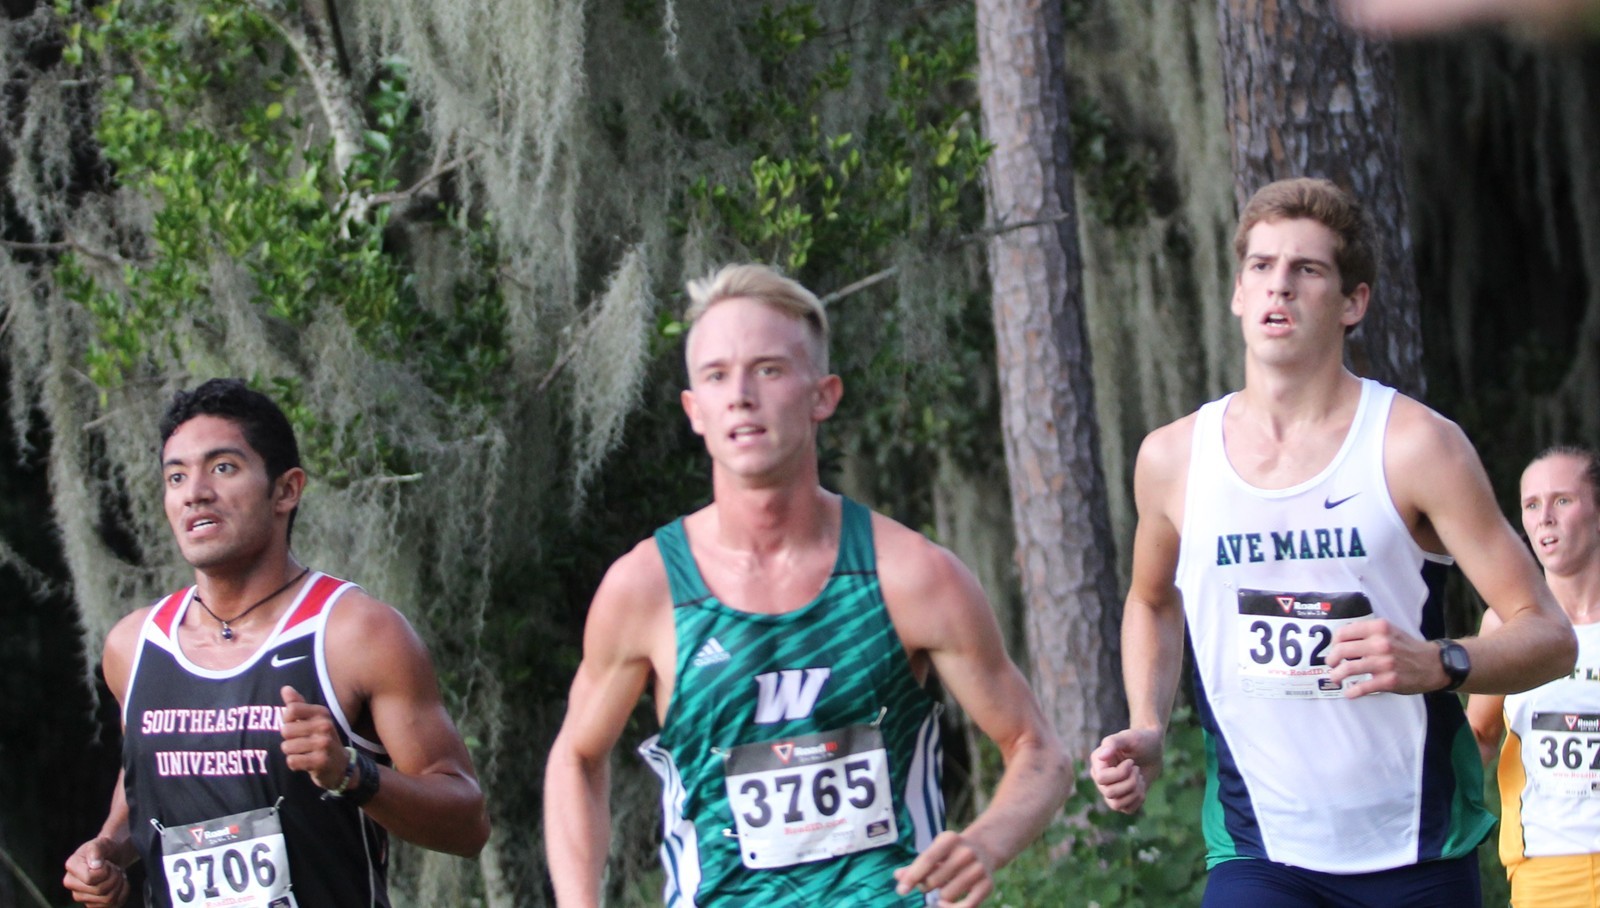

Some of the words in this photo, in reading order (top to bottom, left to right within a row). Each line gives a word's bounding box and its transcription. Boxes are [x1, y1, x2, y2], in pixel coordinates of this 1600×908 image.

[1216, 532, 1265, 566] AVE
[1271, 527, 1367, 560] MARIA
[1249, 620, 1362, 667] 362
[754, 667, 831, 724] W
[141, 704, 286, 735] SOUTHEASTERN
[155, 749, 268, 777] UNIVERSITY
[740, 759, 876, 828] 3765
[173, 842, 276, 903] 3706
